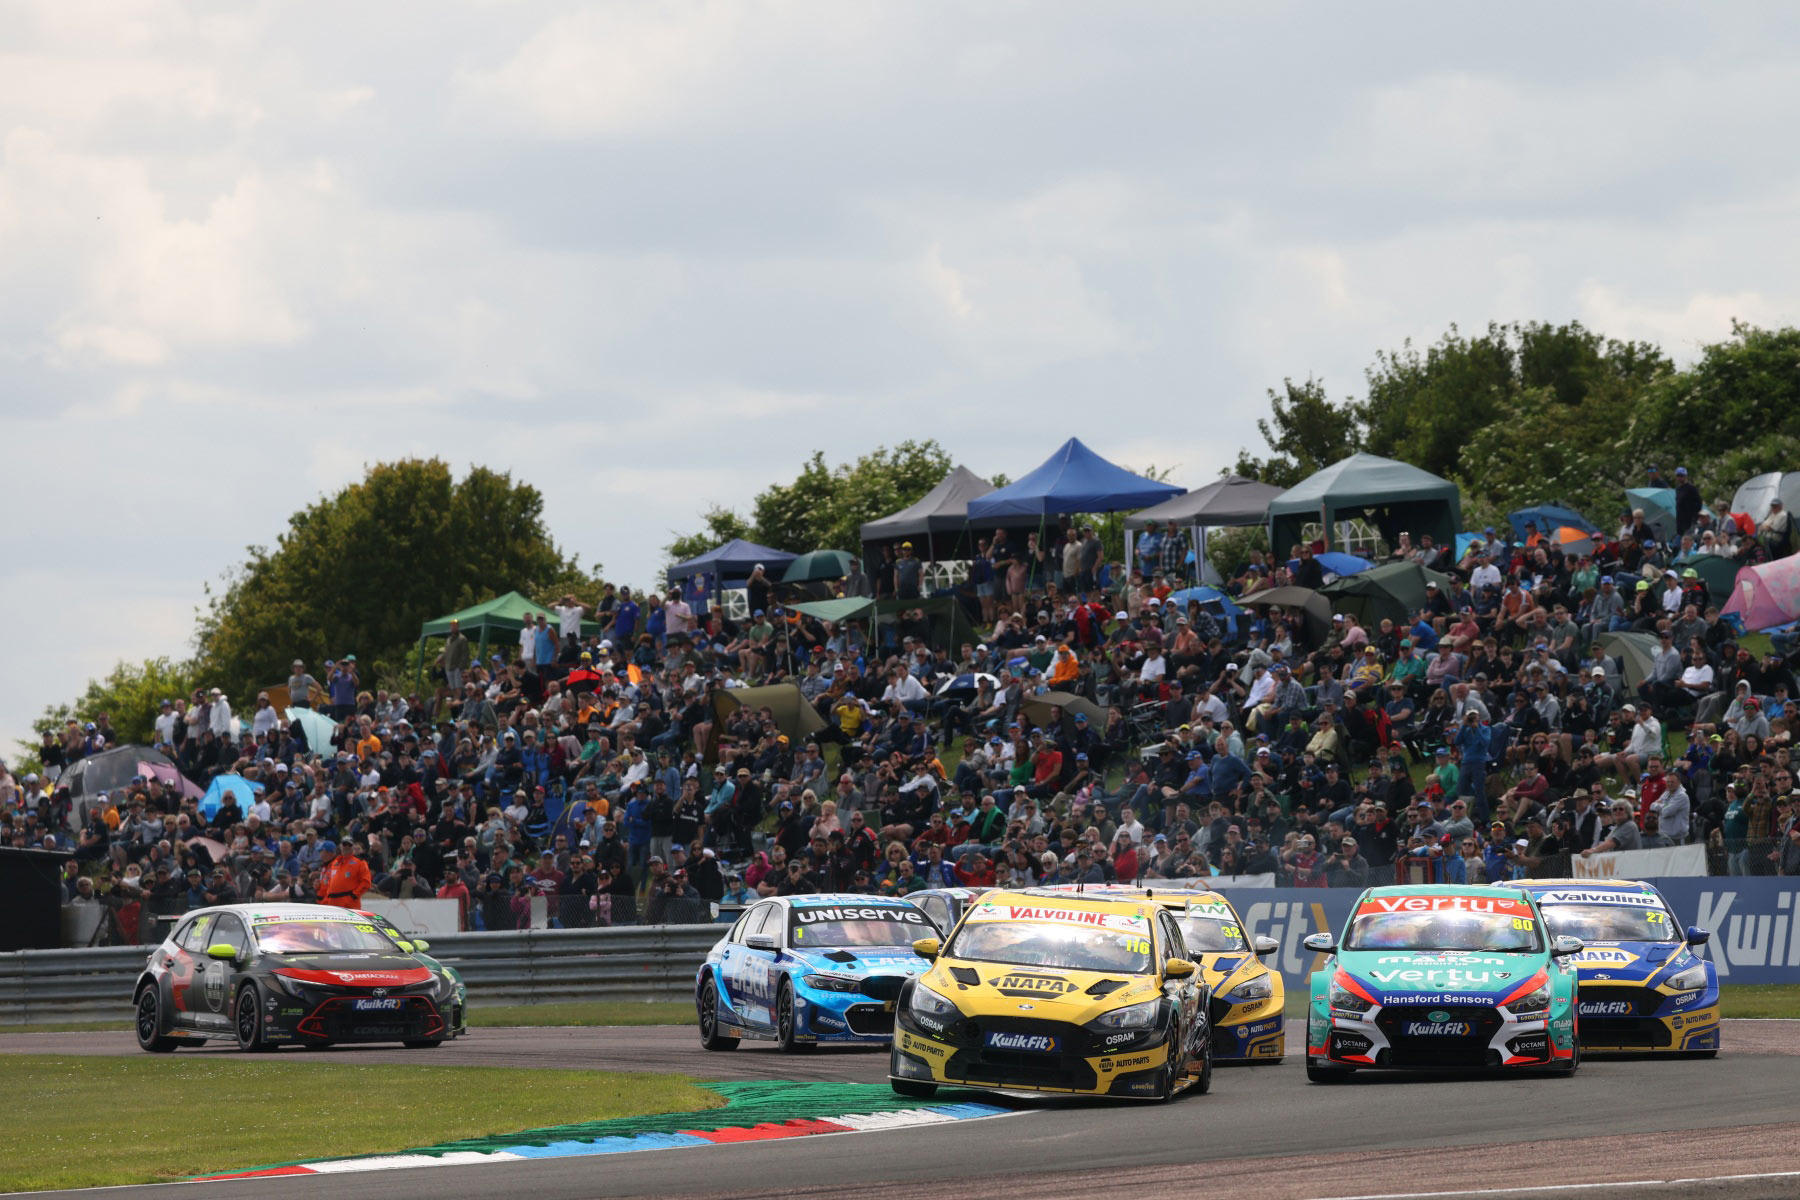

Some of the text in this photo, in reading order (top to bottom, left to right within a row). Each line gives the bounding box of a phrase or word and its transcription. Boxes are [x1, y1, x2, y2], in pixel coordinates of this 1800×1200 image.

[1552, 893, 1655, 905] Valvoline
[1010, 906, 1110, 926] VALVOLINE
[1646, 912, 1665, 924] 27
[1513, 918, 1533, 931] 80
[796, 927, 803, 939] 1
[1221, 926, 1242, 937] 32
[1126, 938, 1150, 955] 116
[1569, 951, 1629, 961] NAPA
[1002, 977, 1064, 992] NAPA
[1383, 994, 1494, 1005] Hansford Sensors
[1676, 993, 1697, 1006] OSRAM
[1242, 1000, 1263, 1014] OSRAM
[920, 1015, 944, 1033] OSRAM
[1686, 1012, 1712, 1025] AUTO PARTS
[1250, 1021, 1277, 1034] AUTO PARTS
[1105, 1031, 1135, 1046] OSRAM
[1342, 1040, 1368, 1049] OCTANE
[1520, 1040, 1546, 1049] OCTANE
[912, 1041, 945, 1058] AUTO PARTS
[1116, 1056, 1150, 1068] AUTO PARTS
